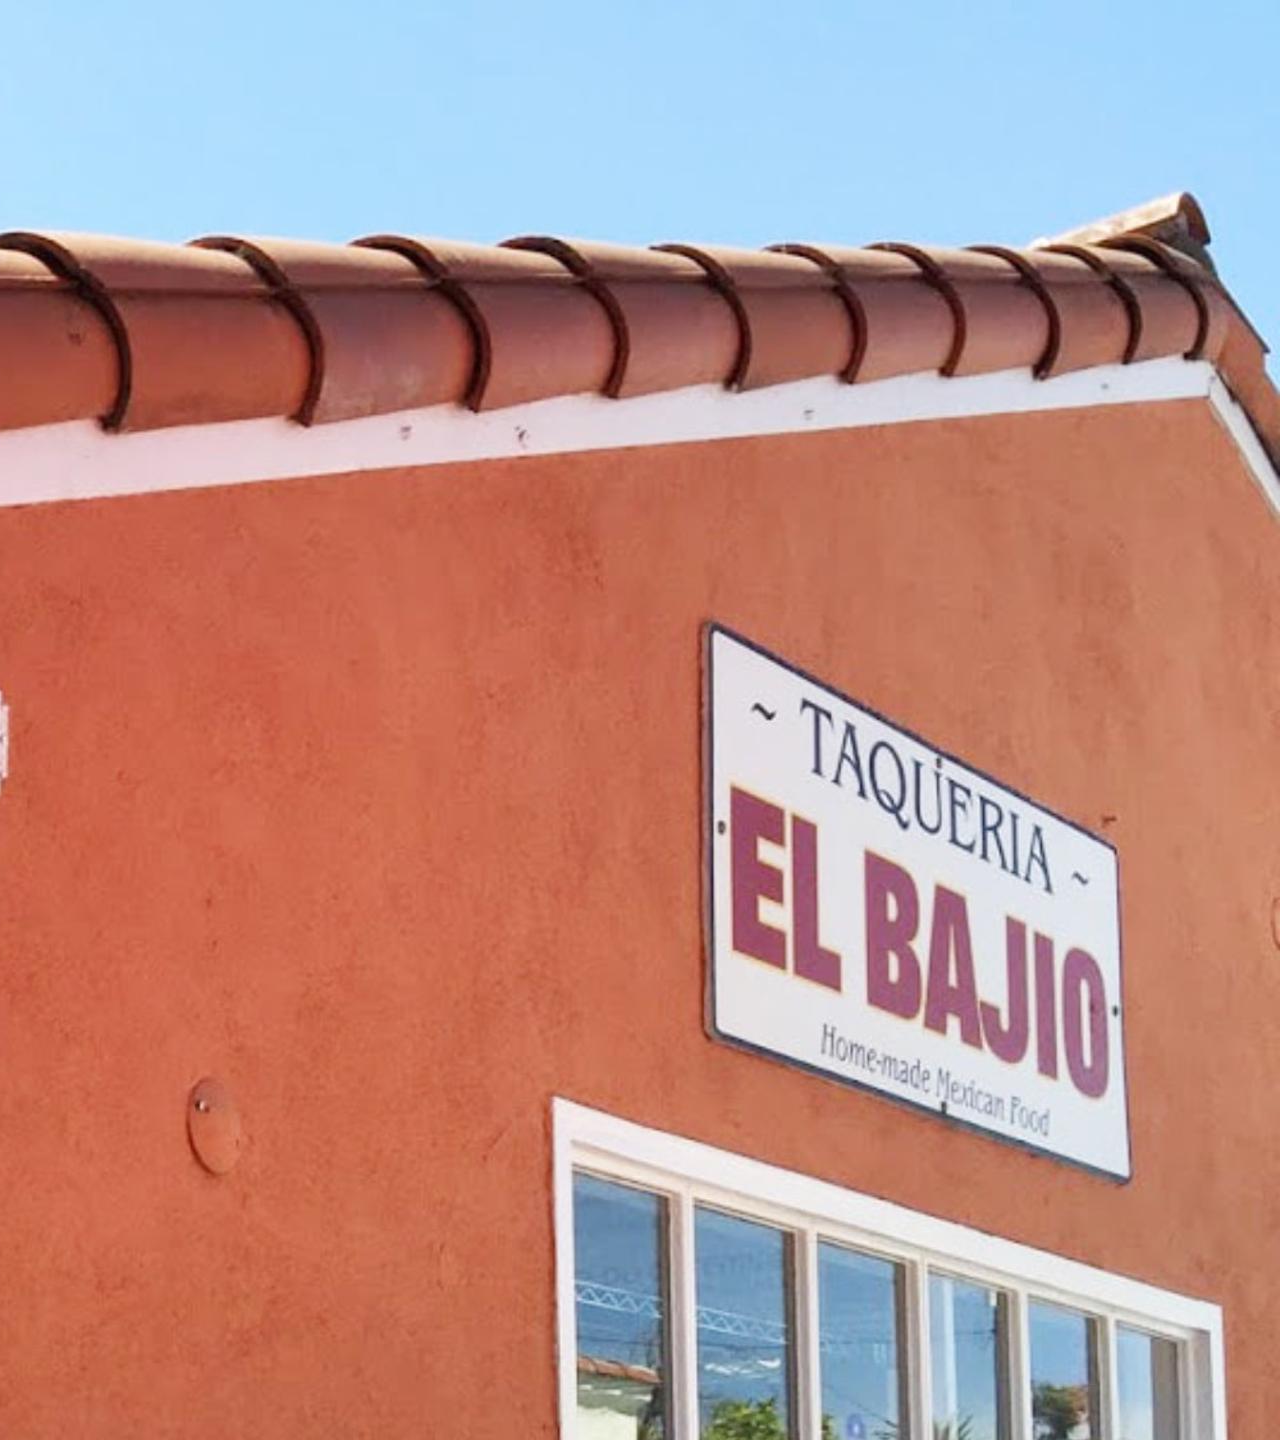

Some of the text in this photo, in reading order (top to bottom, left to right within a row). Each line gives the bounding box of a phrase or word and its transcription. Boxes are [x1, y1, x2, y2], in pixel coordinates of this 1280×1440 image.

[800, 697, 1054, 894] TAQUERIA
[729, 783, 1110, 1100] EL BAJIO
[820, 1023, 1050, 1137] Home-made Mexican Food
